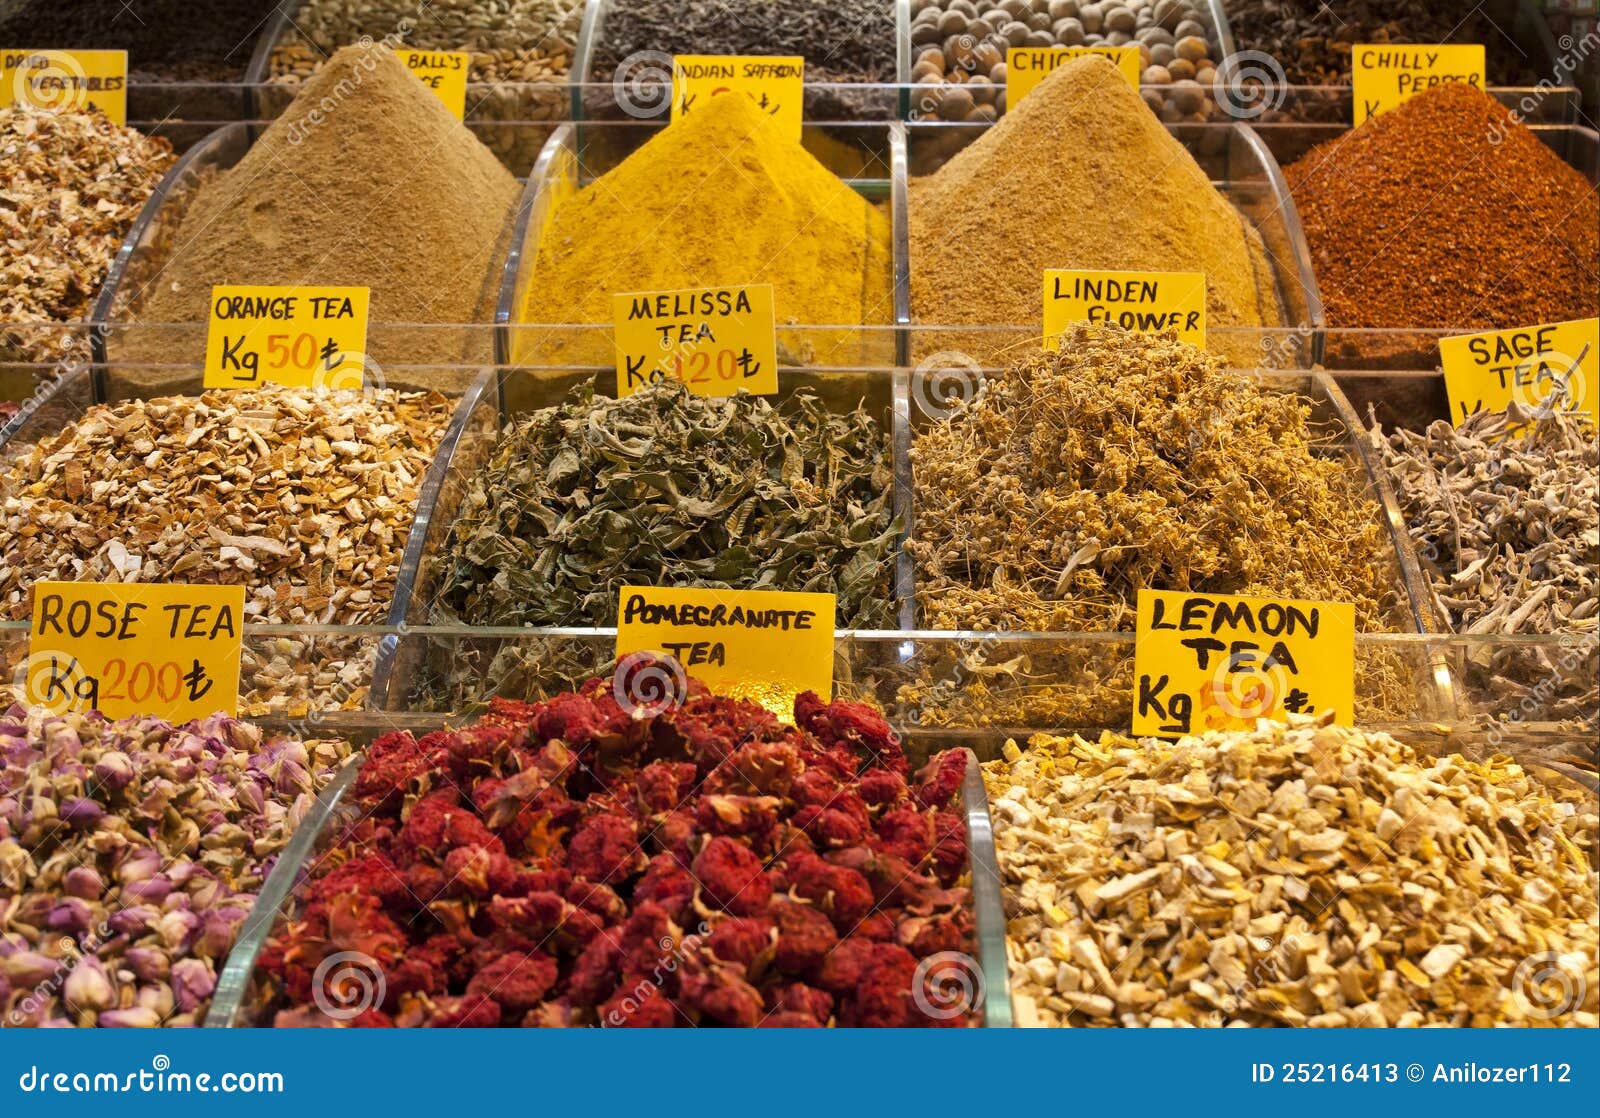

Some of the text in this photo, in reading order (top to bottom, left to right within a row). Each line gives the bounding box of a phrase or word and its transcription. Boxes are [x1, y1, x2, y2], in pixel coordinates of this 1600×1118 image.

[408, 53, 461, 70] BALL'S
[676, 64, 734, 79] INDIAN
[1013, 52, 1121, 70] CHICN
[1361, 51, 1438, 70] CHILLY
[1054, 277, 1158, 303] LINDEN
[215, 296, 353, 320] ORANGE TEA
[628, 290, 752, 320] MELISSA
[656, 322, 715, 344] TEA
[1469, 326, 1557, 365] SAGE
[222, 335, 258, 381] Kg
[1489, 361, 1555, 389] TEA
[39, 594, 234, 640] ROSE TEA
[624, 594, 816, 631] POMEGRANATE
[1151, 598, 1319, 639] LEMON
[661, 641, 725, 667] TEA
[1181, 637, 1298, 675] TEA
[1139, 674, 1192, 733] Kg
